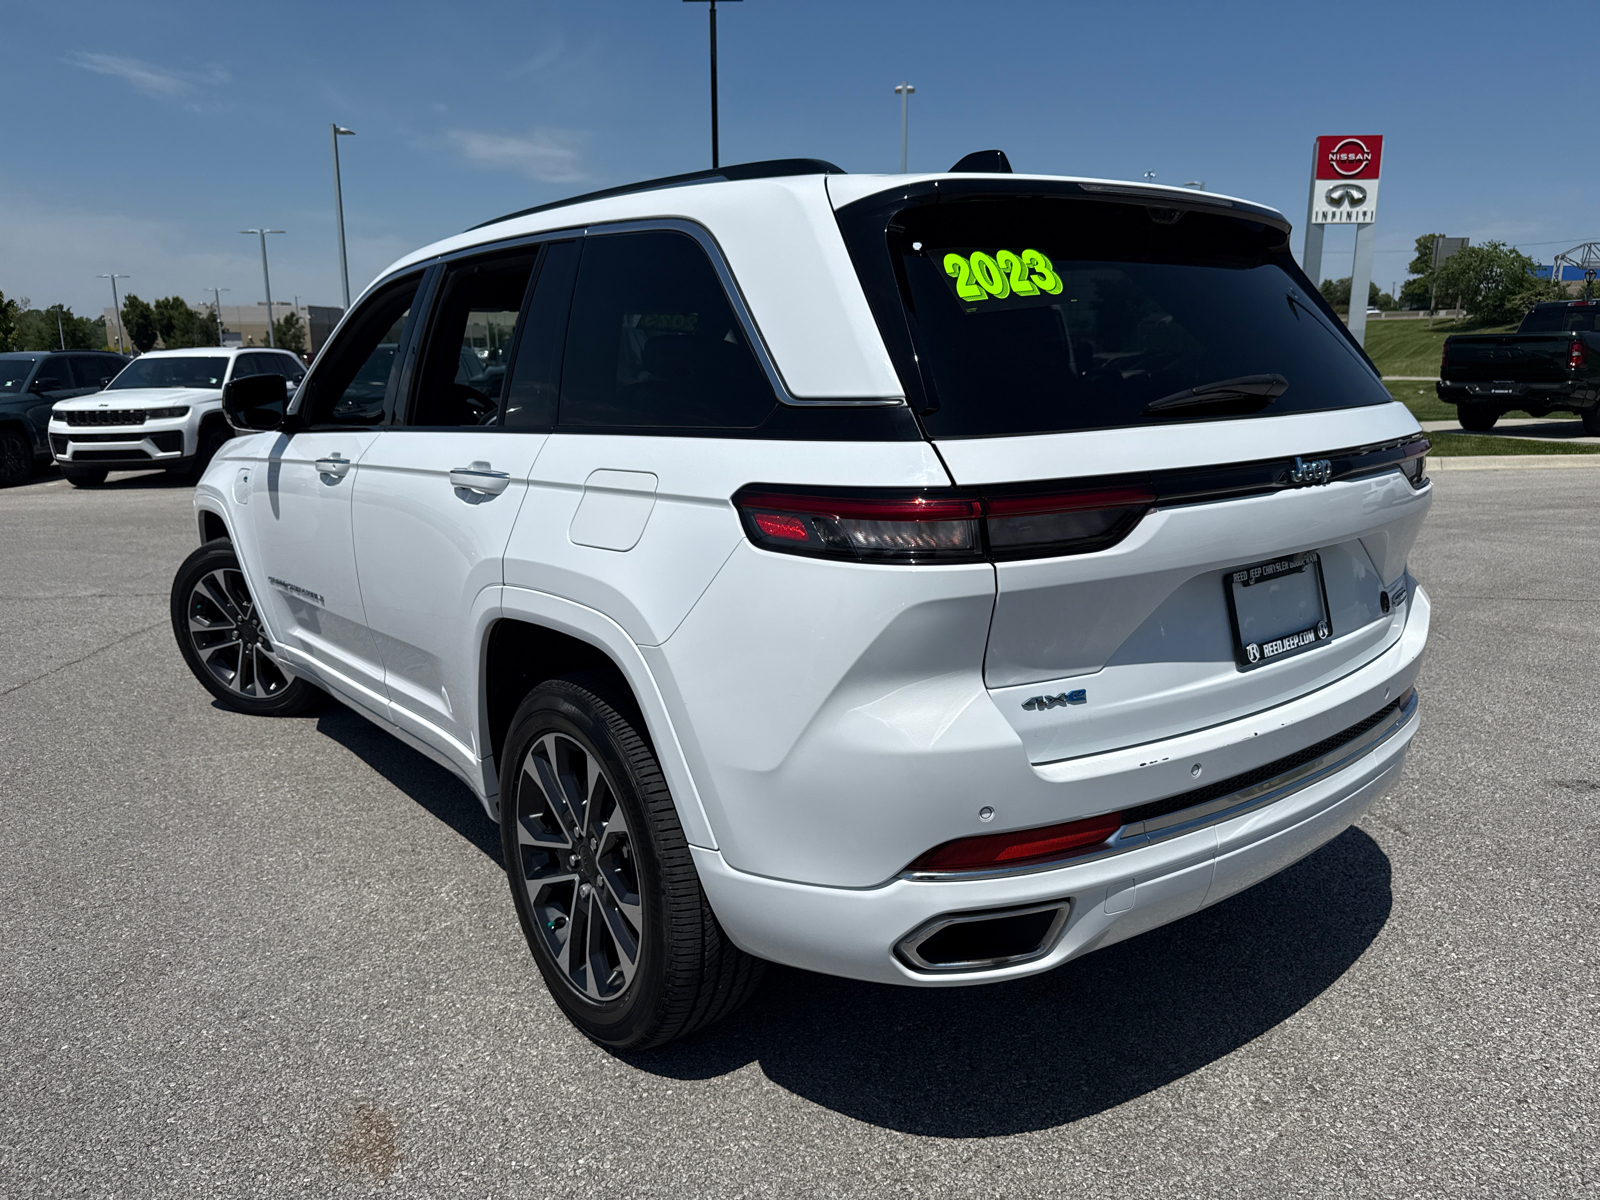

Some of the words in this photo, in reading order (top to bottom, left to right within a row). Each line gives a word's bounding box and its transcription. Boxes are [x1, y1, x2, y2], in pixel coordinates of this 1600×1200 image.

[1328, 153, 1371, 161] NISSAN
[1315, 210, 1374, 222] INFINITI
[943, 249, 1064, 302] 2023
[1290, 456, 1332, 483] Jeep
[1232, 570, 1248, 583] REED
[1249, 566, 1262, 579] JEEP
[1262, 561, 1289, 576] CHRYSLER
[1262, 629, 1316, 658] REEDJEEP.COM
